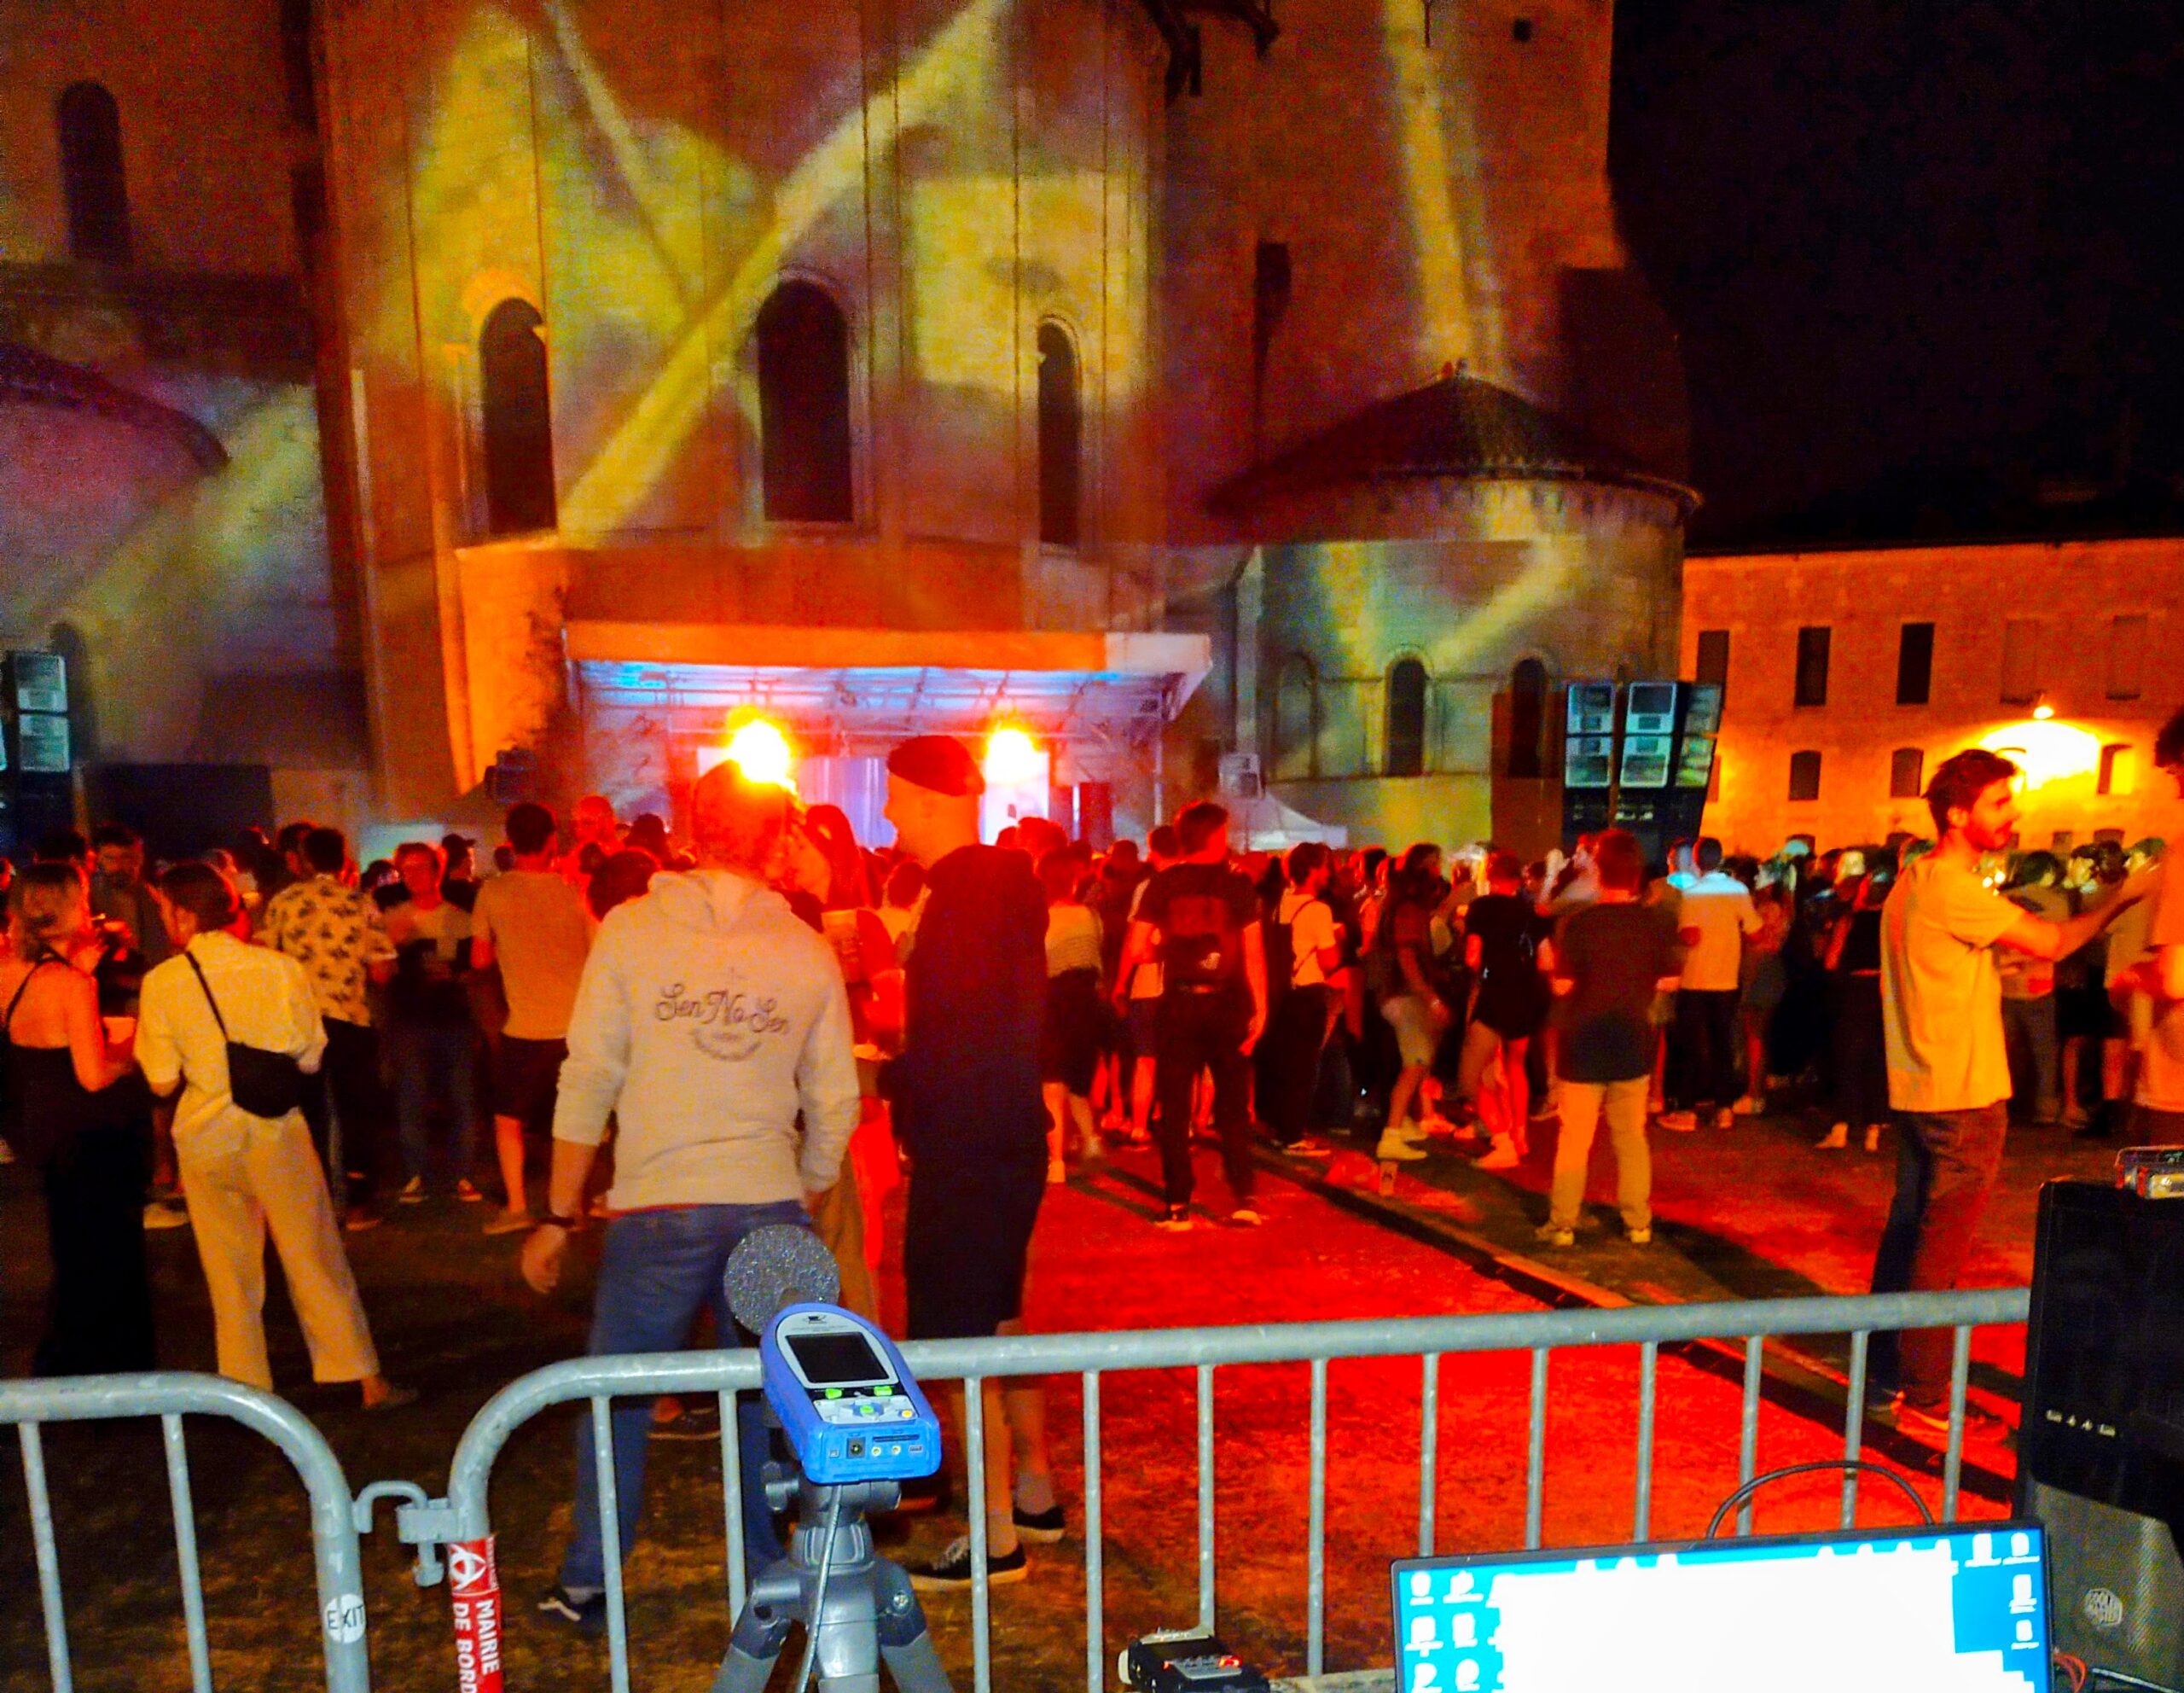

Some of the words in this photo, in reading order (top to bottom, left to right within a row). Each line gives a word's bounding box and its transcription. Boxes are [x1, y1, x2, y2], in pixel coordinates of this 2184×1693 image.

[327, 1604, 364, 1630] EXIT
[452, 1603, 472, 1632] DE
[475, 1600, 501, 1675] MAIRIE
